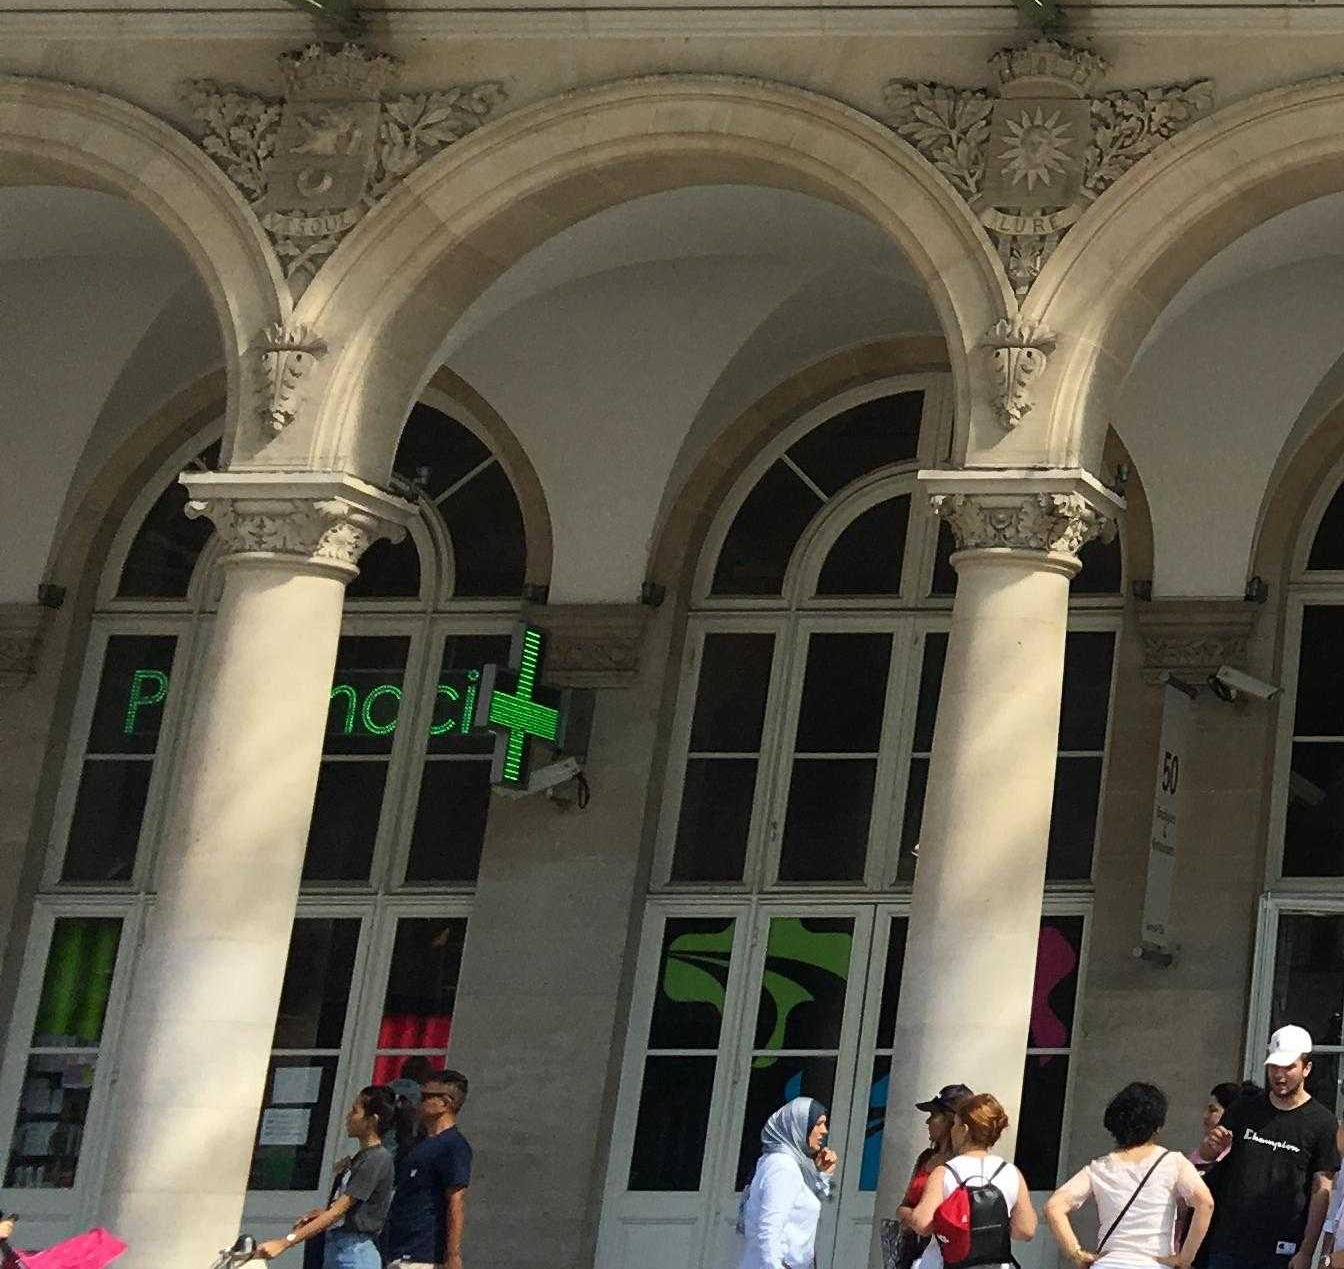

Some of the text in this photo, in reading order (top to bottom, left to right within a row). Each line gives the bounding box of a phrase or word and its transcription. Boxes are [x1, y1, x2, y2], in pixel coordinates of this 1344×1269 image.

[999, 213, 1064, 233] LURE
[1162, 751, 1179, 795] 50
[1243, 1128, 1301, 1152] Champion
